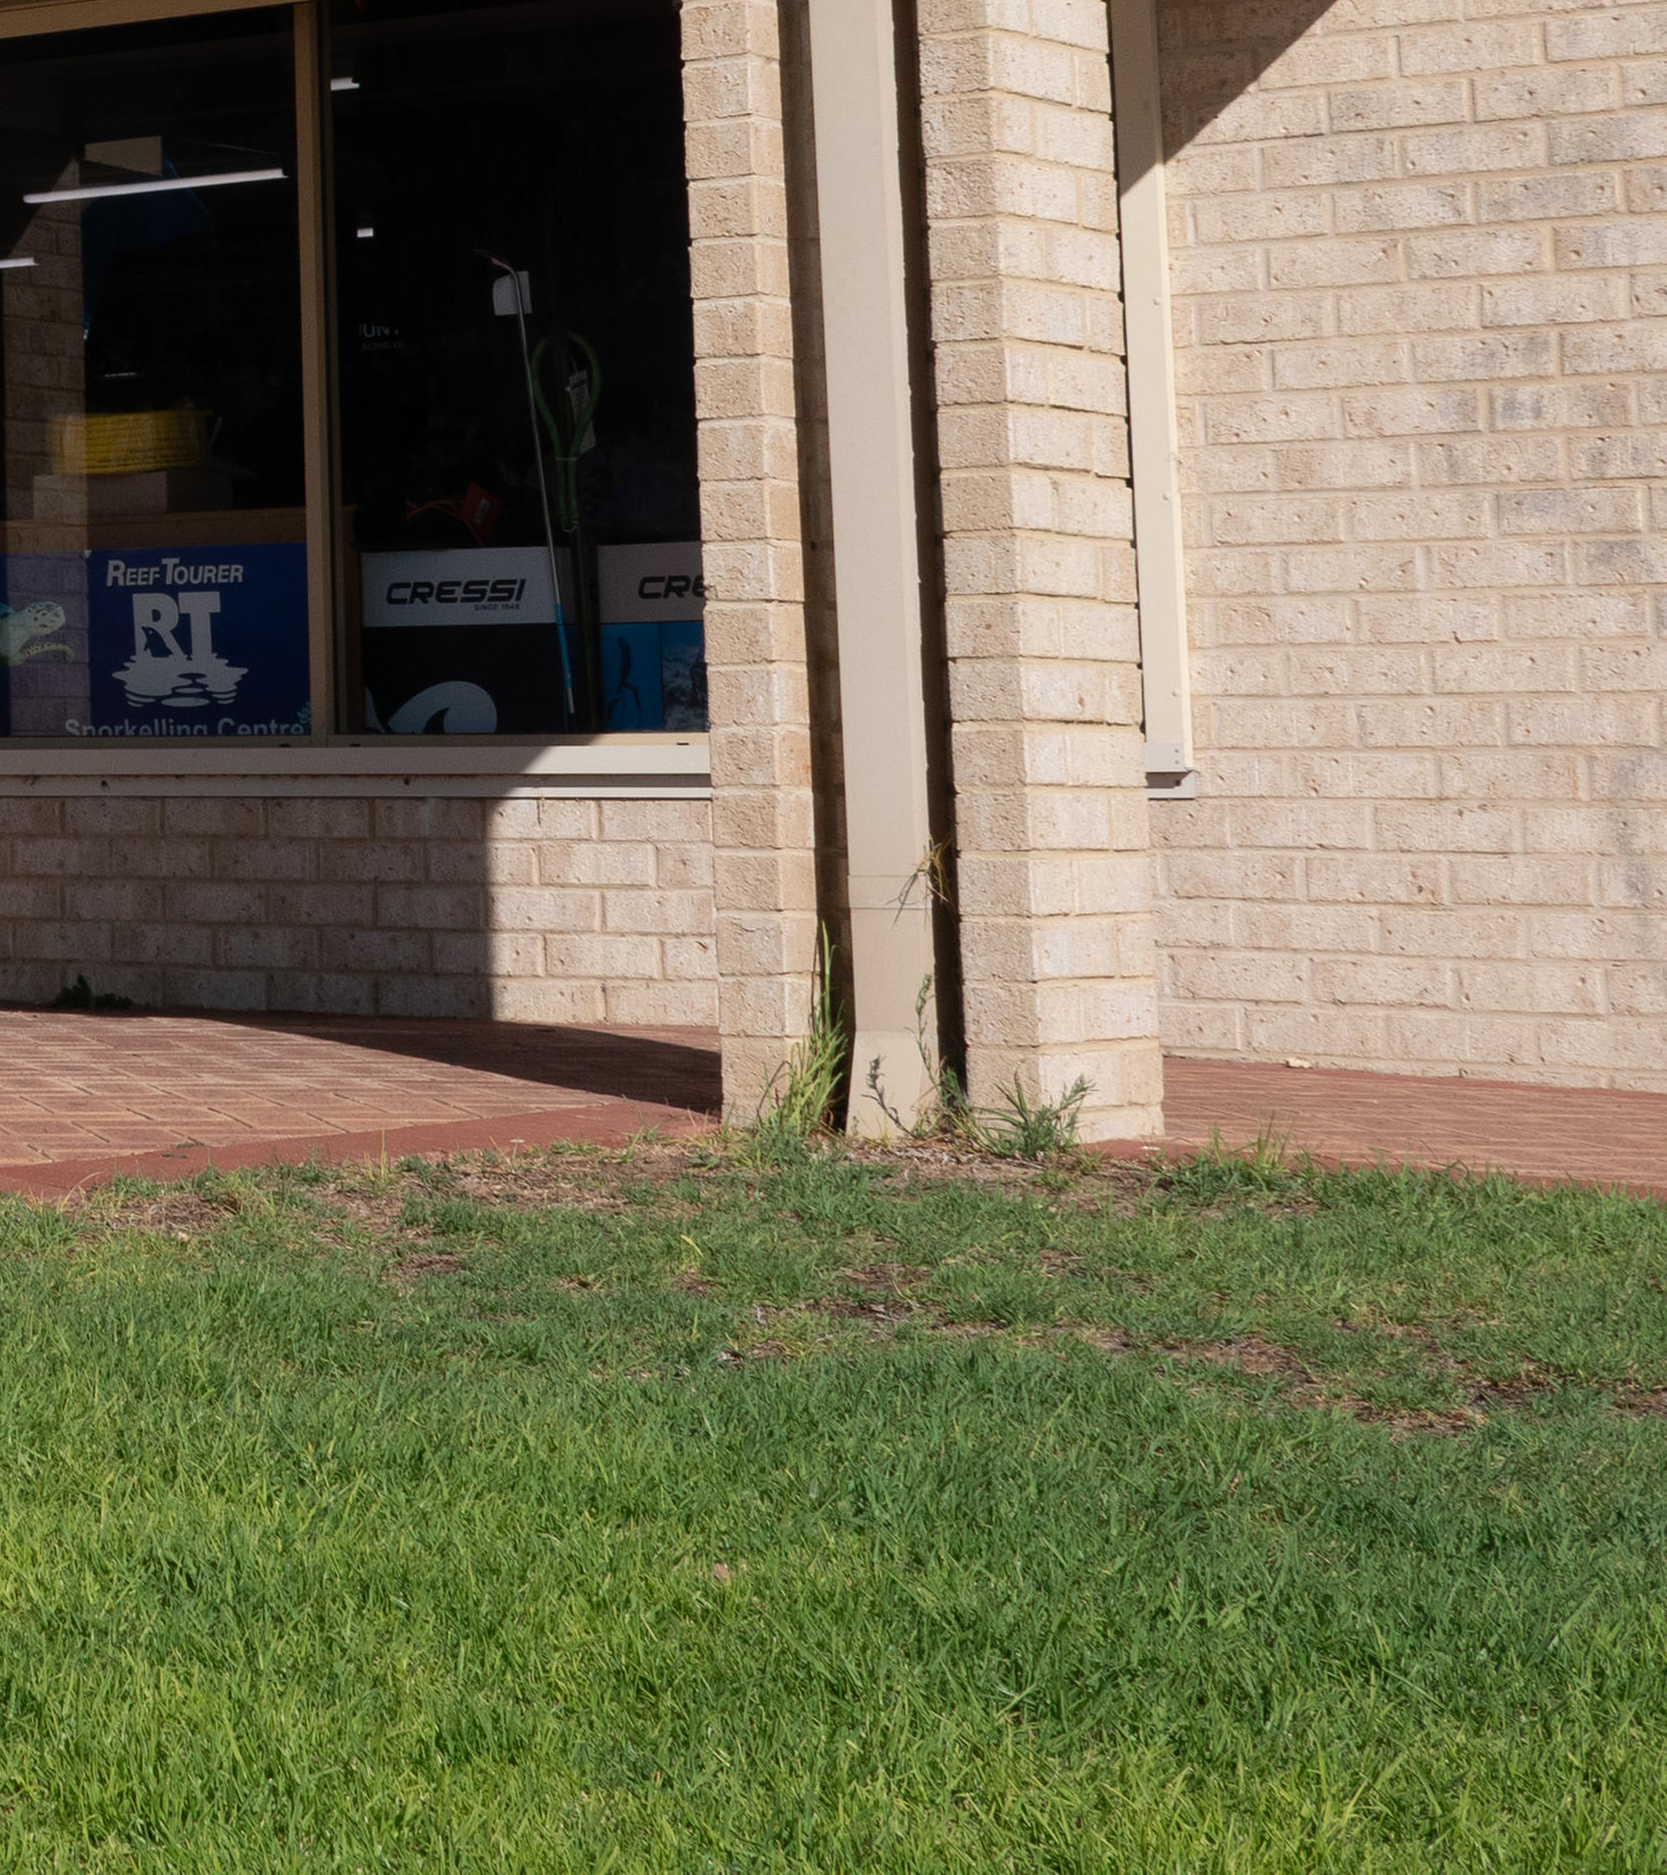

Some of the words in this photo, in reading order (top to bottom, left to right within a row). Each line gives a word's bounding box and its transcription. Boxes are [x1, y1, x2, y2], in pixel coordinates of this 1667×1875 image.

[105, 559, 161, 588] REEF
[161, 556, 244, 585] TOURER
[386, 578, 527, 605] CRESSI
[132, 590, 222, 661] RT
[216, 716, 306, 736] Centre
